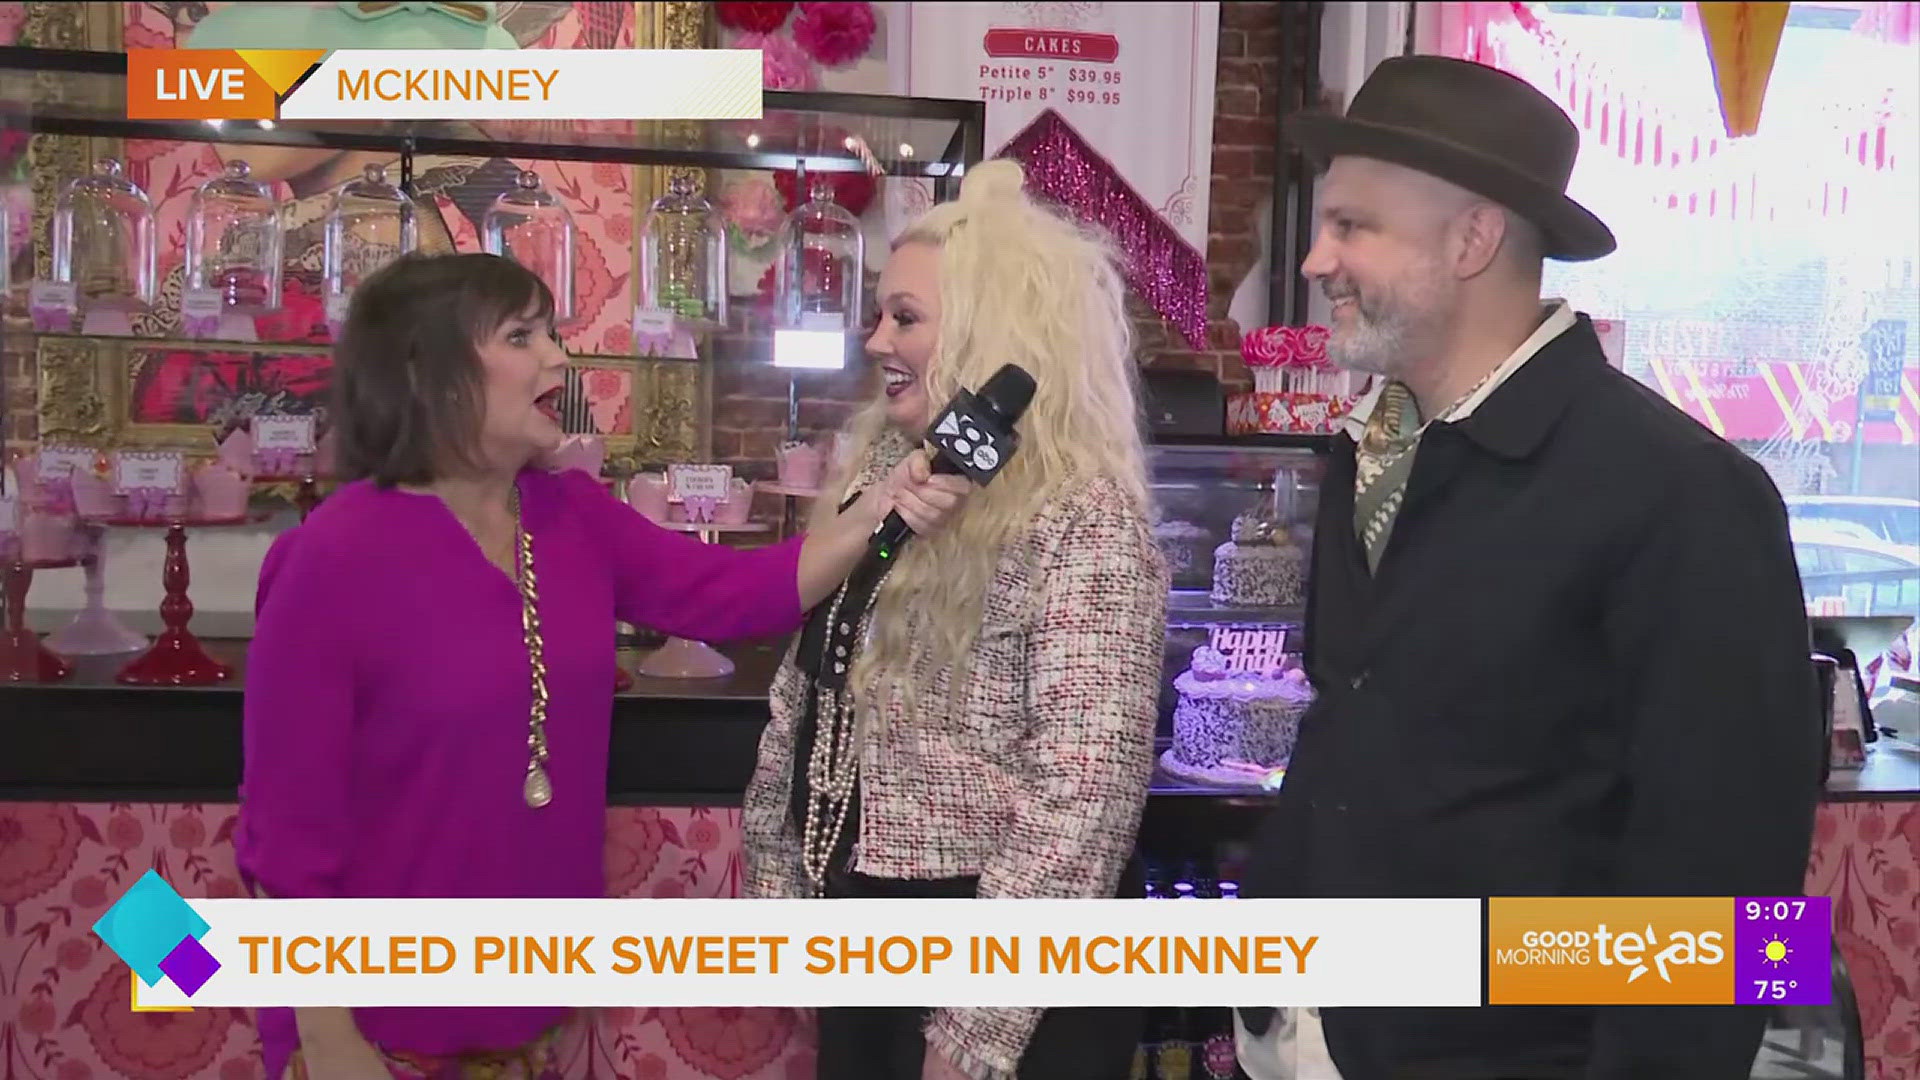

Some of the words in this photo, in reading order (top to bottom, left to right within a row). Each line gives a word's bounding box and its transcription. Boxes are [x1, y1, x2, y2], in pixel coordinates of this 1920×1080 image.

[1024, 36, 1082, 54] CAKES
[979, 65, 1031, 80] Petite
[1068, 67, 1121, 84] $39.95
[979, 86, 1032, 104] Triple
[1067, 88, 1121, 105] $99.95
[1211, 628, 1286, 653] Happy
